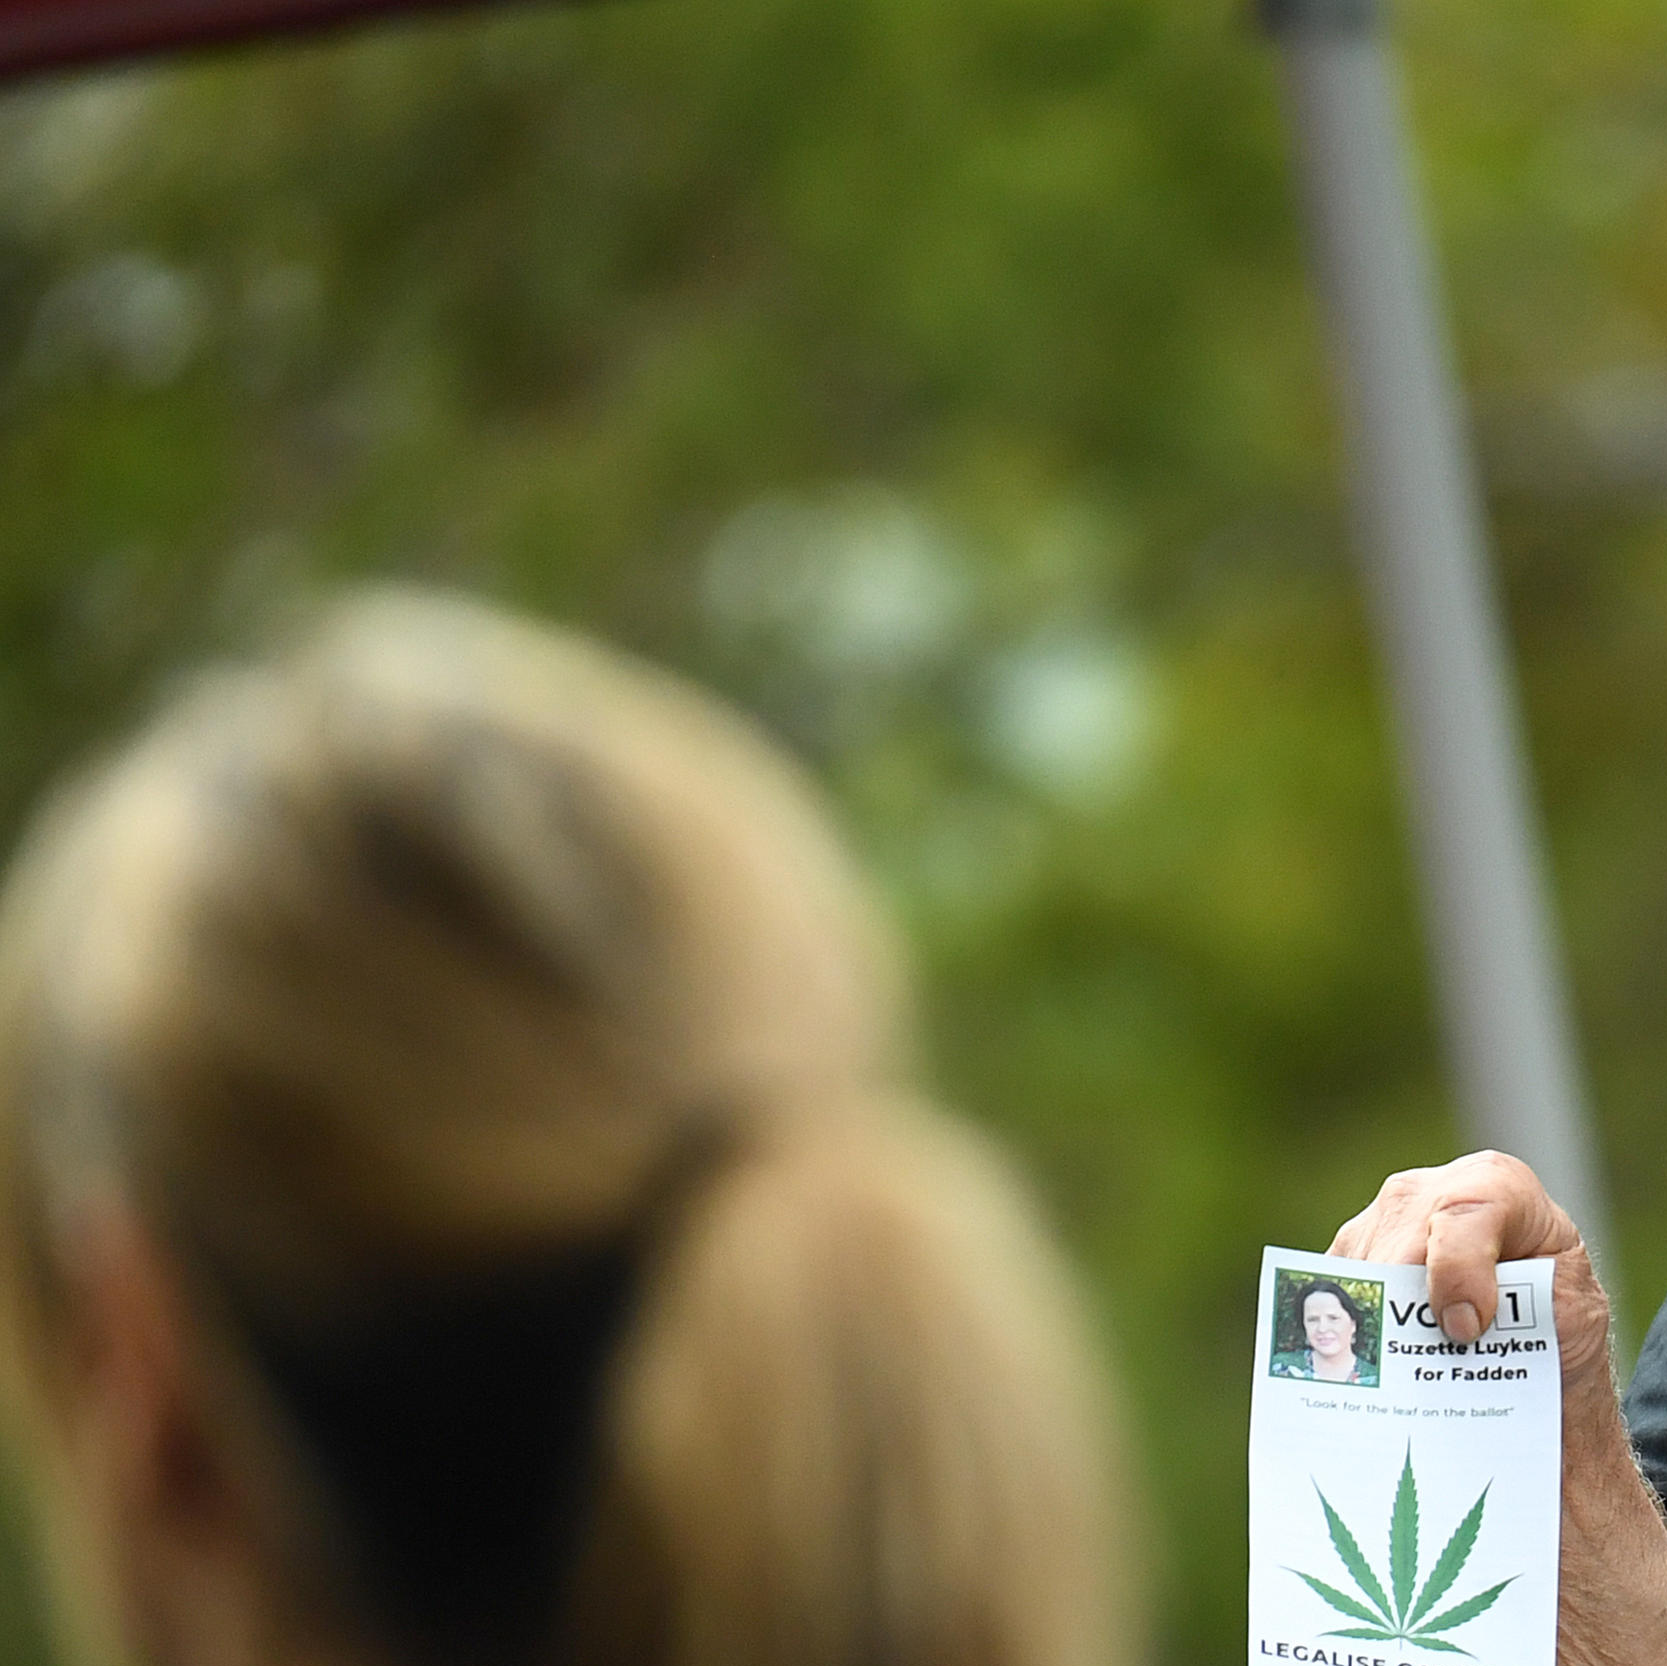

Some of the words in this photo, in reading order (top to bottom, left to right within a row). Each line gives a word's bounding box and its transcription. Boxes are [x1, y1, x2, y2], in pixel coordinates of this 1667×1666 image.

[1505, 1292, 1520, 1322] 1
[1388, 1340, 1468, 1355] Suzette
[1475, 1338, 1547, 1357] Luyken
[1414, 1367, 1445, 1381] for
[1451, 1366, 1528, 1381] Fadden
